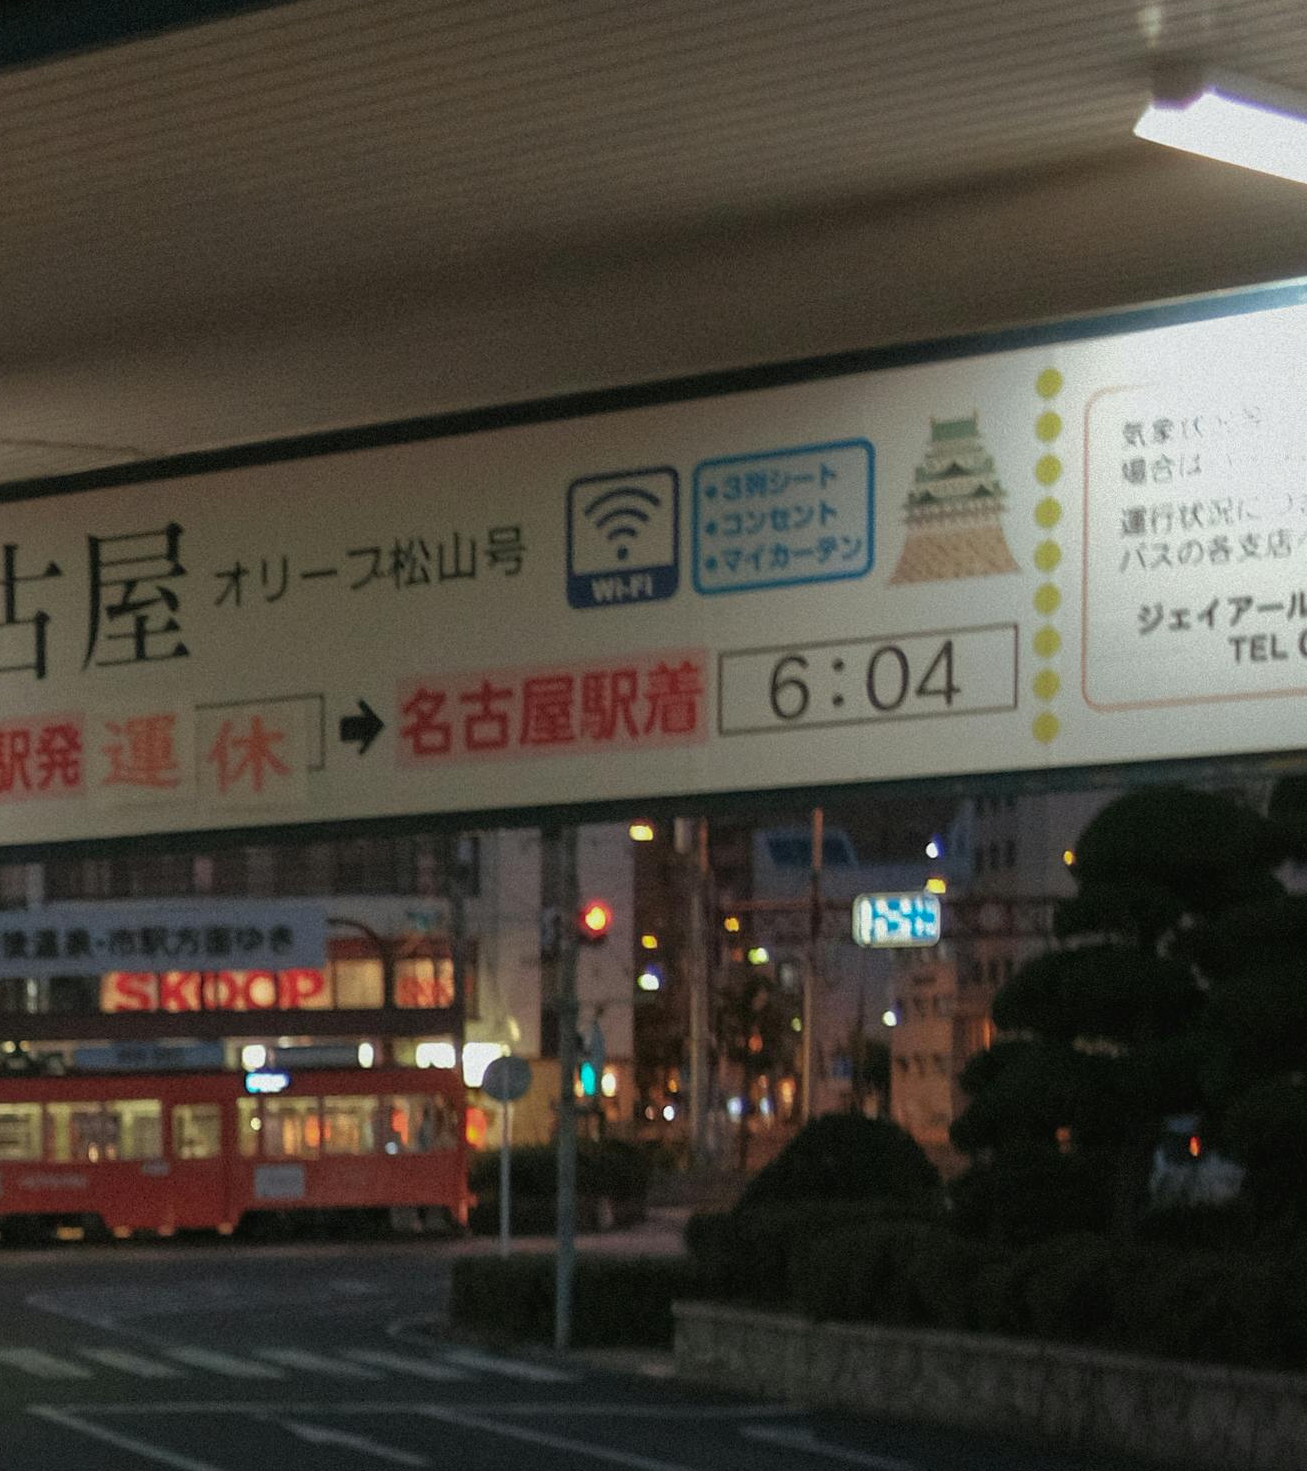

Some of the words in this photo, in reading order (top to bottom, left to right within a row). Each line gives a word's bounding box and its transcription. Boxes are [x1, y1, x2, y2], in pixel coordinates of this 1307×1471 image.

[769, 639, 961, 722] 6:04
[1228, 633, 1289, 665] TEL
[101, 714, 292, 793] 運休
[400, 659, 703, 758] 名古屋駅着
